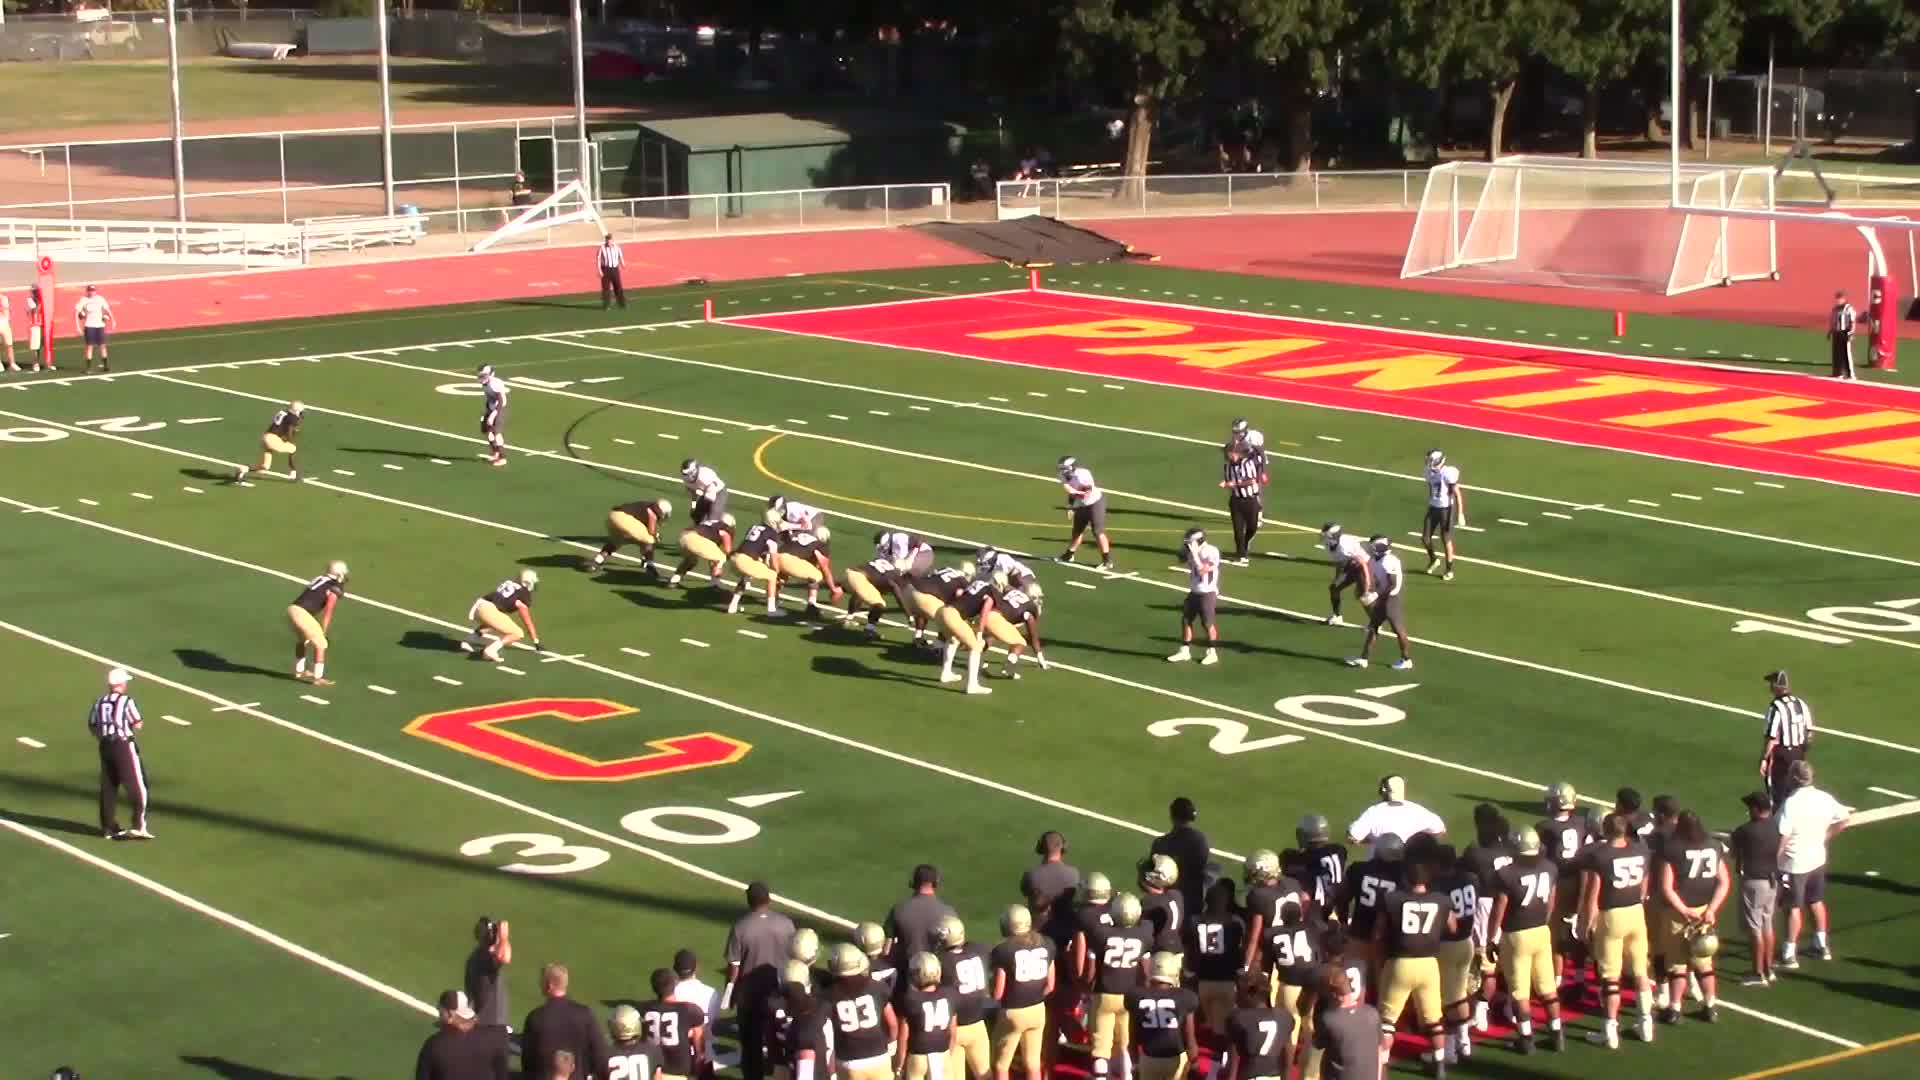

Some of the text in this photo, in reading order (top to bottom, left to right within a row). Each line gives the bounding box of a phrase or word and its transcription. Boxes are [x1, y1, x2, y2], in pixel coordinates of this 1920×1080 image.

[964, 318, 1920, 467] PANTH
[402, 698, 752, 781] C
[1562, 829, 1578, 859] 9
[1612, 856, 1644, 889] 55
[1685, 848, 1717, 879] 73
[1450, 884, 1477, 918] 99
[1520, 871, 1550, 906] 74
[1402, 901, 1439, 935] 67
[1103, 937, 1142, 968] 22
[1272, 930, 1312, 966] 34
[644, 1011, 679, 1046] 33
[836, 994, 878, 1032] 93
[921, 998, 950, 1033] 14
[1138, 999, 1178, 1028] 36
[1258, 1020, 1277, 1055] 7
